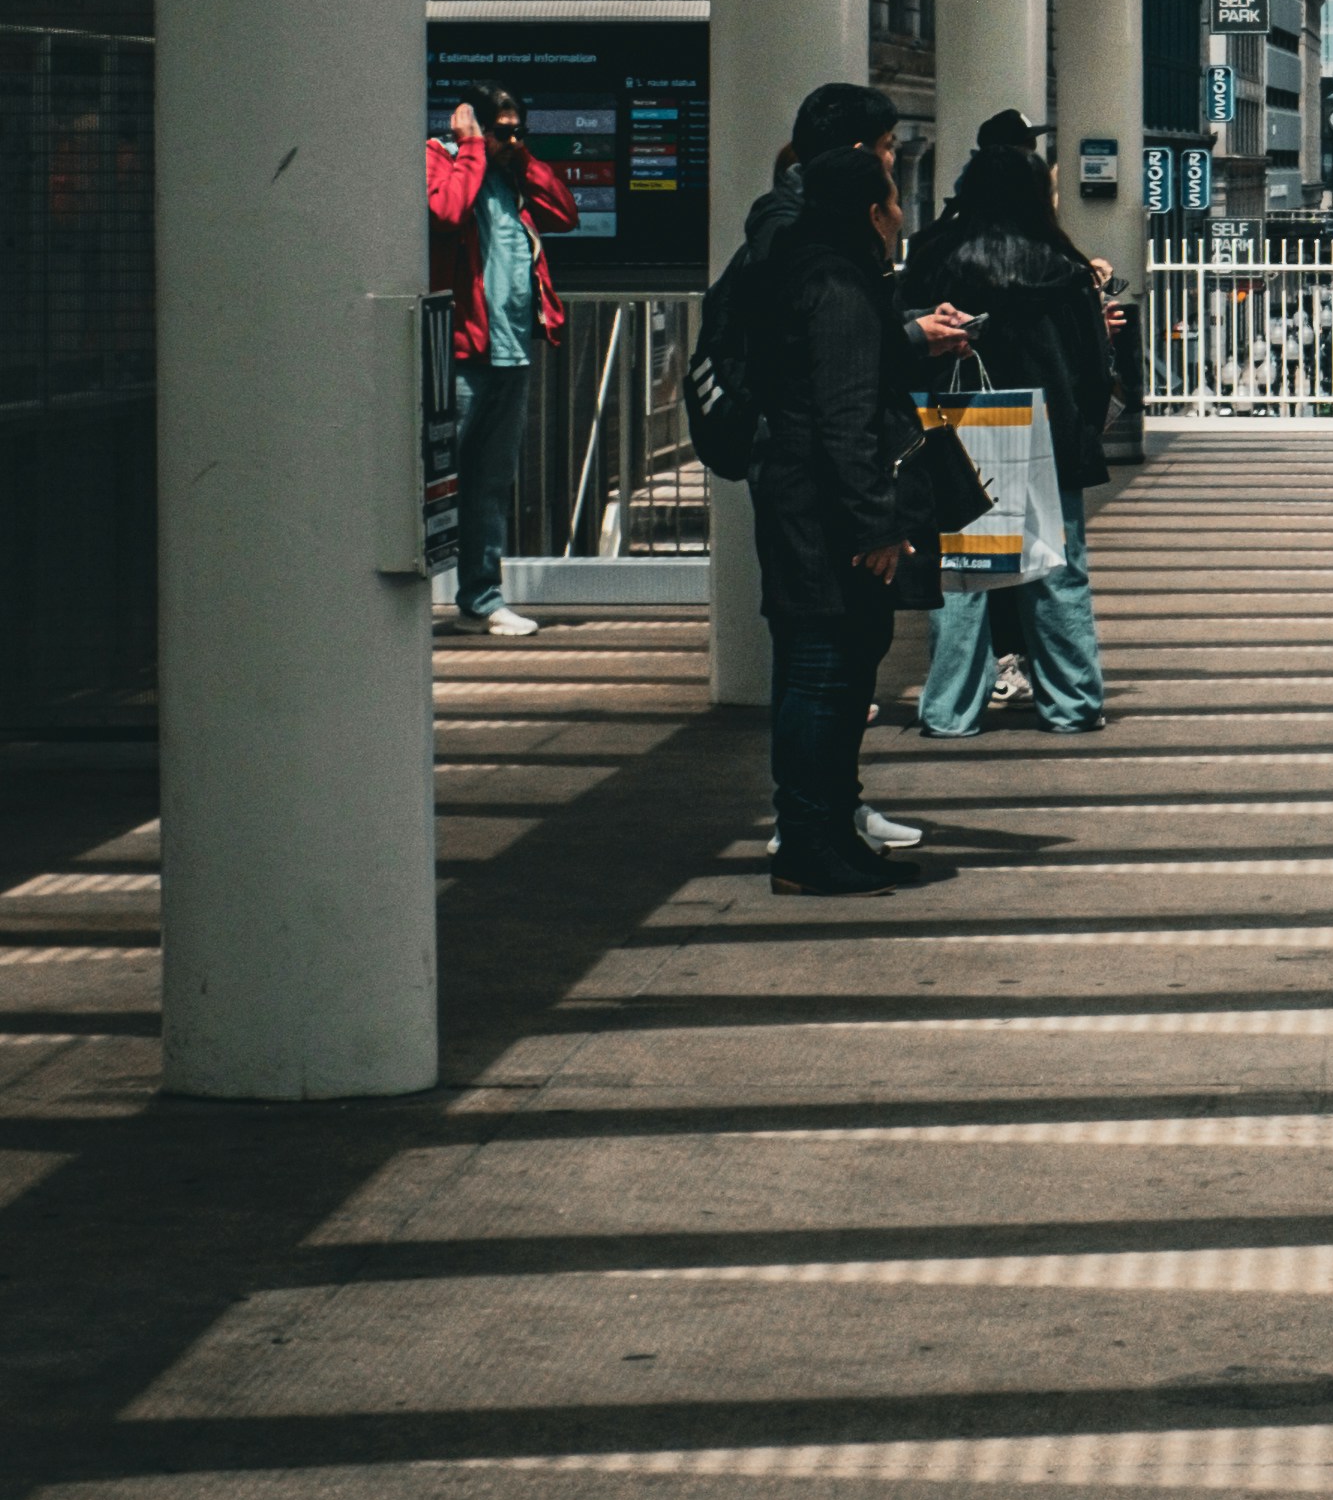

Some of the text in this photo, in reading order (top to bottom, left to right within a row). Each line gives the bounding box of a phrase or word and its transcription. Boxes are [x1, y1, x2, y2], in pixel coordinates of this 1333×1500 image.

[1219, 9, 1260, 23] PARK
[439, 52, 597, 63] Estimated arrival information
[1213, 68, 1227, 120] ROSS
[576, 117, 598, 127] Due
[573, 142, 582, 155] 2
[566, 167, 581, 180] 11
[1187, 152, 1202, 207] ROSS
[1147, 152, 1163, 211] ROSS
[1211, 222, 1249, 237] SELF
[428, 309, 451, 412] W
